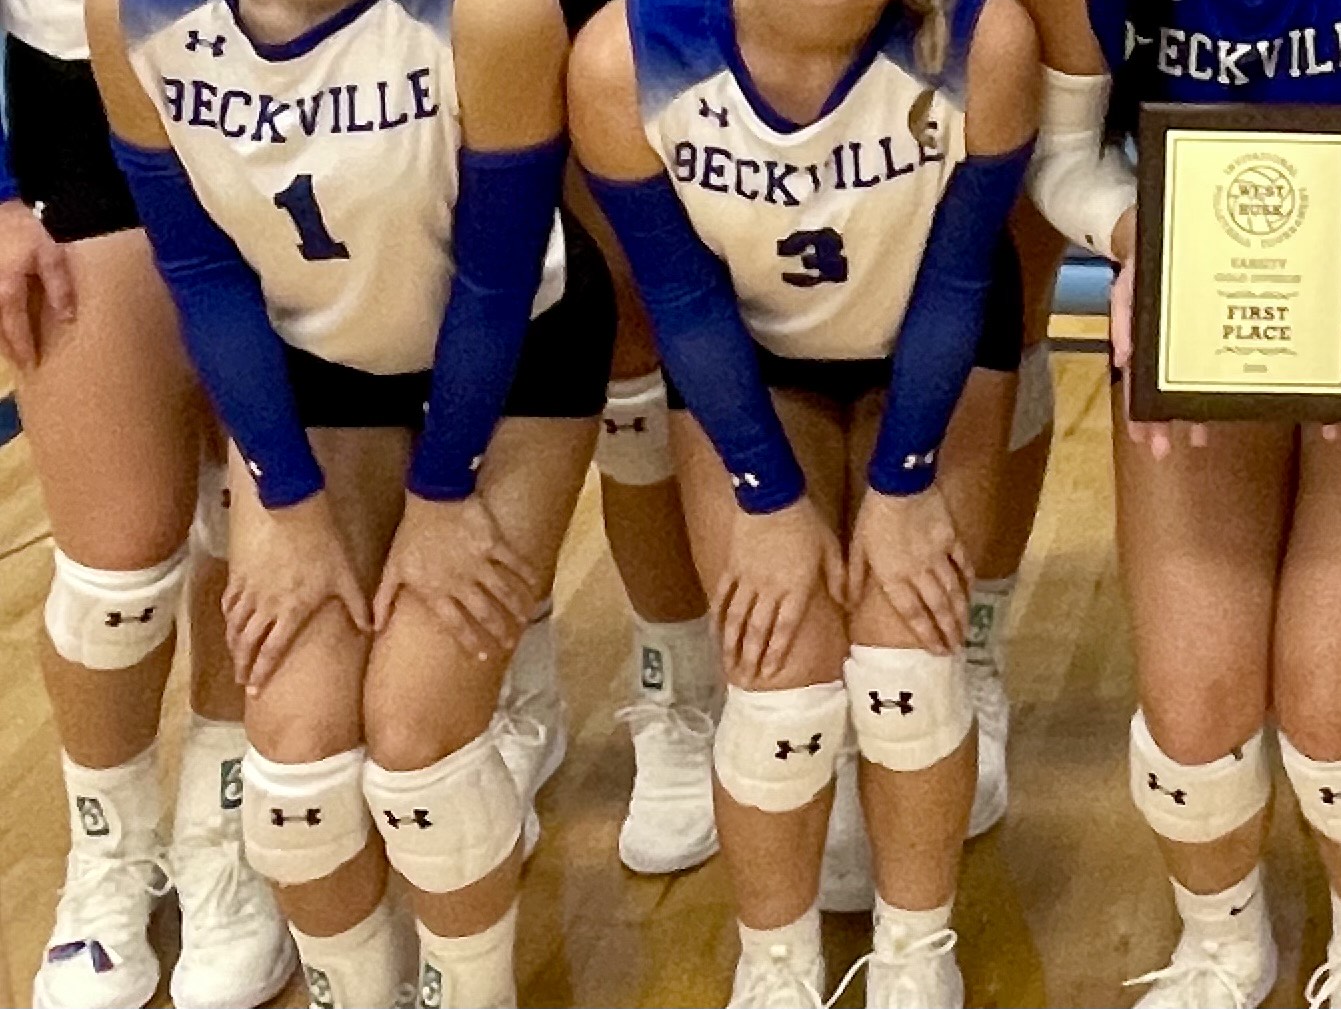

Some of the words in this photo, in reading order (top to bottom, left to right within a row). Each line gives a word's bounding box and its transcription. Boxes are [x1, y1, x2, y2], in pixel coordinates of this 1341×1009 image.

[273, 174, 351, 261] 1
[776, 227, 848, 287] 3
[1226, 304, 1290, 321] FIRST
[1222, 325, 1292, 341] PLACE
